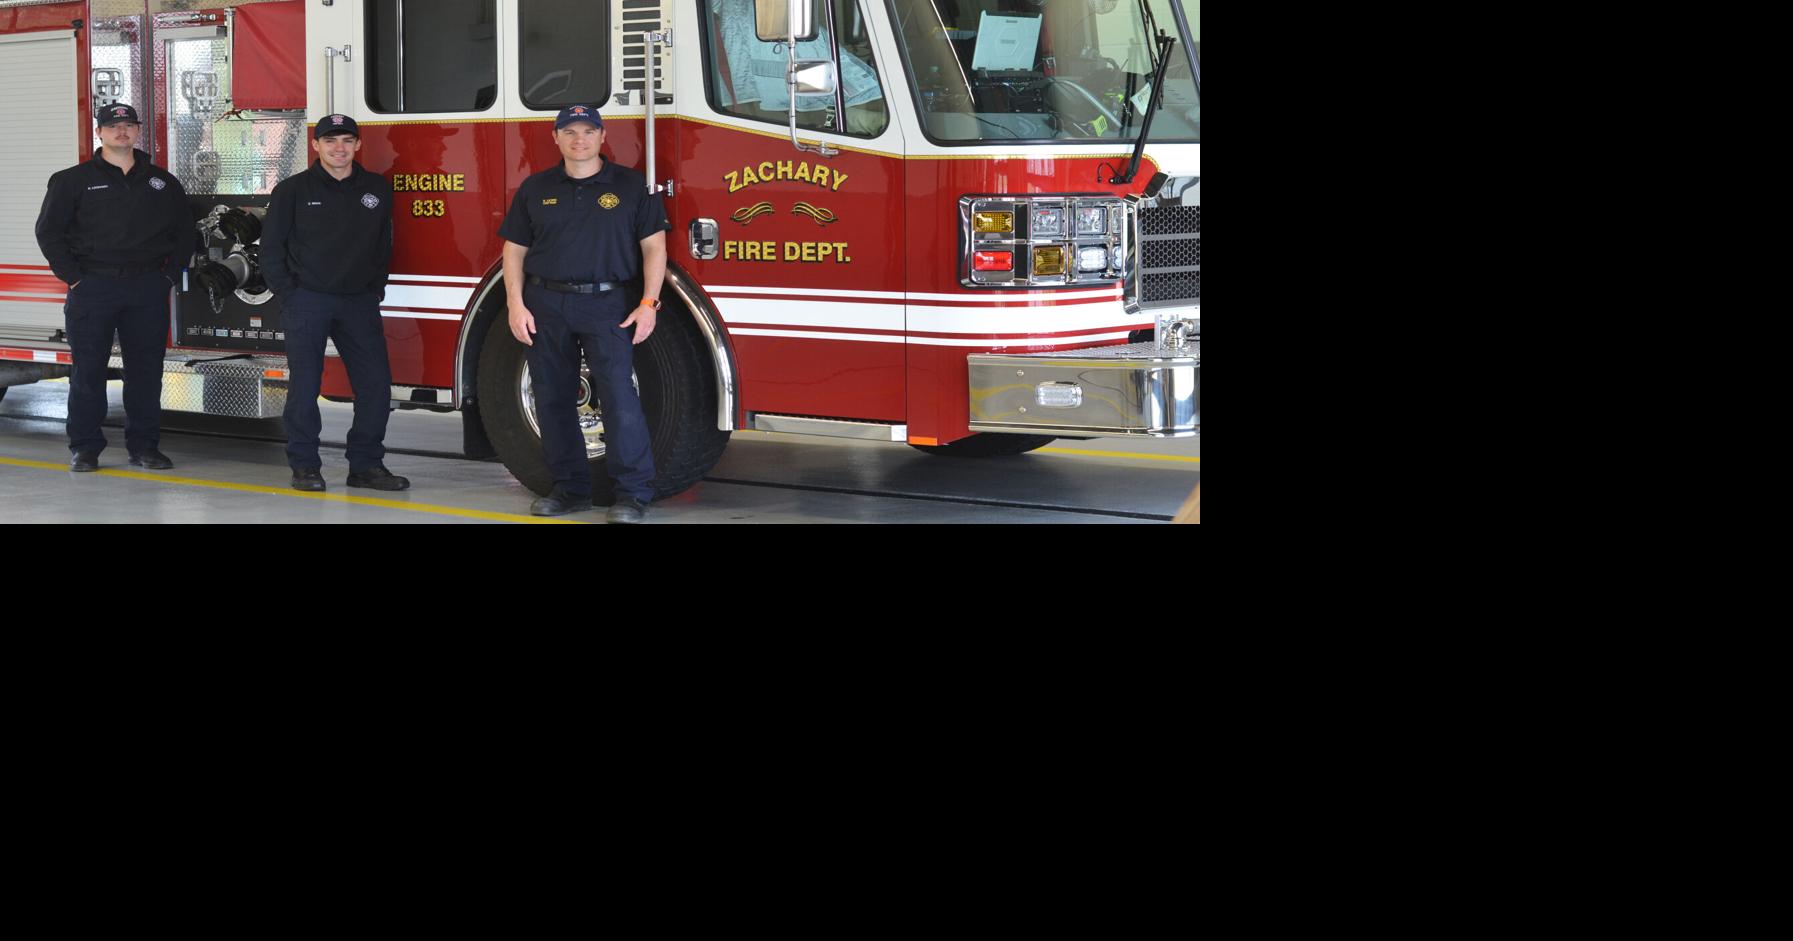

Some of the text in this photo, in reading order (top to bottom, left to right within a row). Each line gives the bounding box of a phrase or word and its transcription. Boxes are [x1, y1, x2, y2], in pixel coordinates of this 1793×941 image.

[393, 173, 465, 192] ENGINE
[723, 160, 849, 194] ZACHARY
[412, 199, 445, 217] 833
[723, 239, 852, 263] FIRE DEPT.
